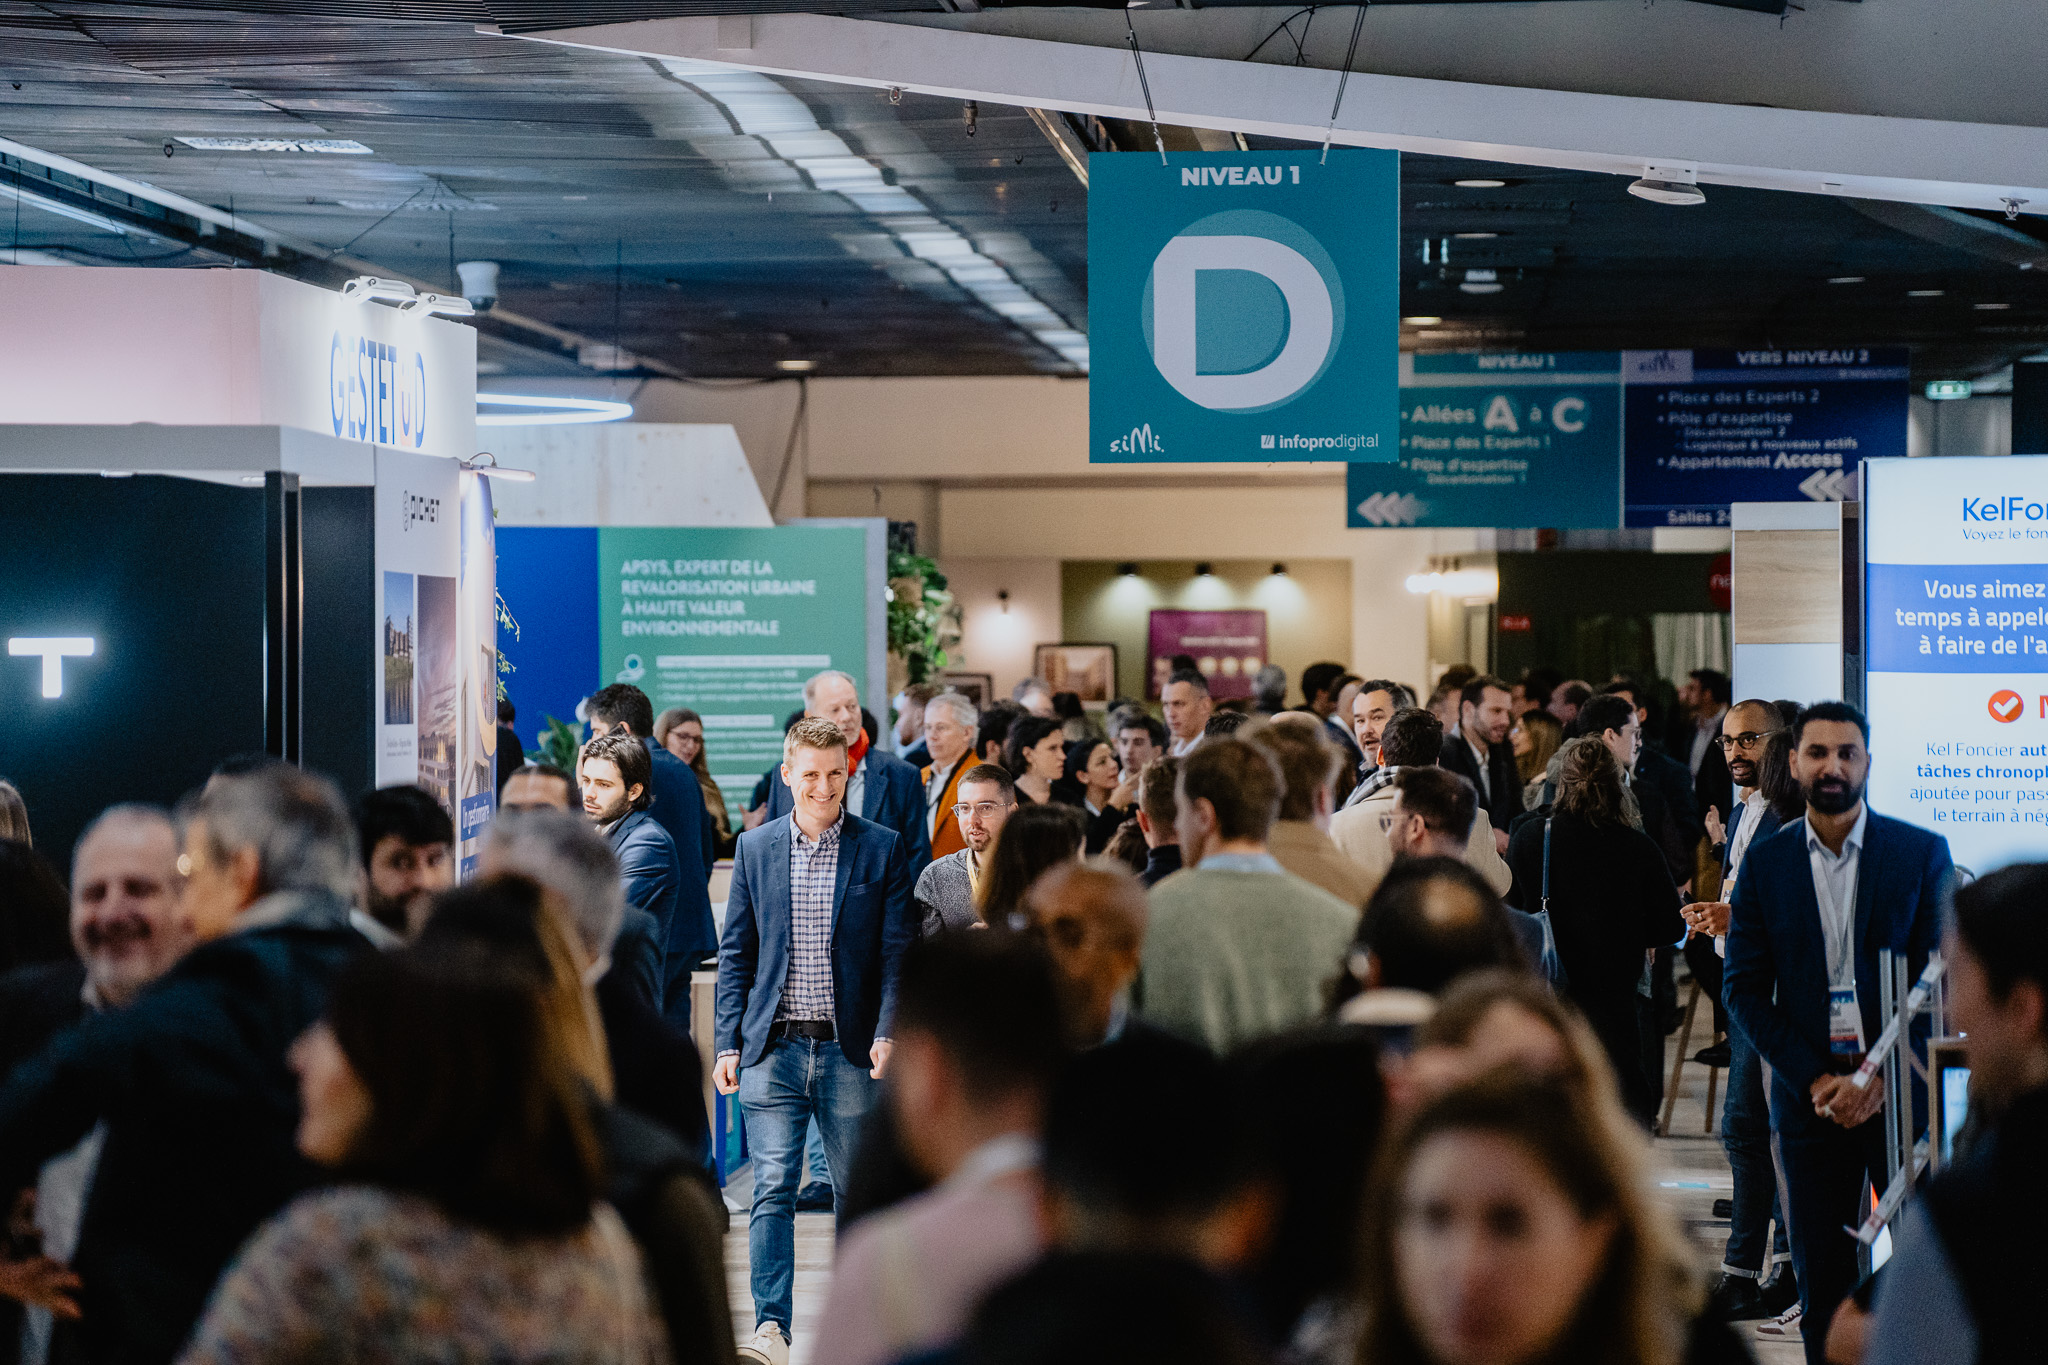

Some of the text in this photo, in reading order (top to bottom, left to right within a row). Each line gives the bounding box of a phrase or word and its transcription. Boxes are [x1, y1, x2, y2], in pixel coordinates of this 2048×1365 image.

[1181, 165, 1300, 187] NIVEAU 1
[1153, 235, 1333, 409] D
[1478, 354, 1544, 369] NIVEAU
[1411, 395, 1586, 434] Allées A à C
[1279, 433, 1379, 452] infoprodigital
[1667, 451, 1844, 471] Appartement Access
[1667, 508, 1713, 525] Salles
[1963, 496, 2048, 521] KelFo
[1963, 528, 2004, 543] Voyez
[2009, 527, 2021, 540] le
[674, 559, 729, 576] EXPERT
[731, 560, 751, 576] DE
[753, 560, 774, 576] LA
[620, 579, 817, 596] REVALORISATION URBAINE
[1924, 579, 2046, 599] Vous aimez
[634, 600, 686, 616] HAUTE
[688, 600, 746, 616] VALEUR
[621, 619, 780, 637] ENVIRONNEMENTALE
[1895, 607, 1962, 631] temps
[1967, 606, 1980, 627] à
[1919, 634, 1932, 654] à
[1937, 635, 1986, 655] faire
[1991, 635, 2018, 655] de
[8, 637, 94, 698] T
[1926, 742, 2047, 757] Kel Foncier aut
[1917, 763, 1971, 778] tâches
[1910, 785, 2048, 804] ajoutée pour pas
[1933, 807, 2048, 826] le terrain à né
